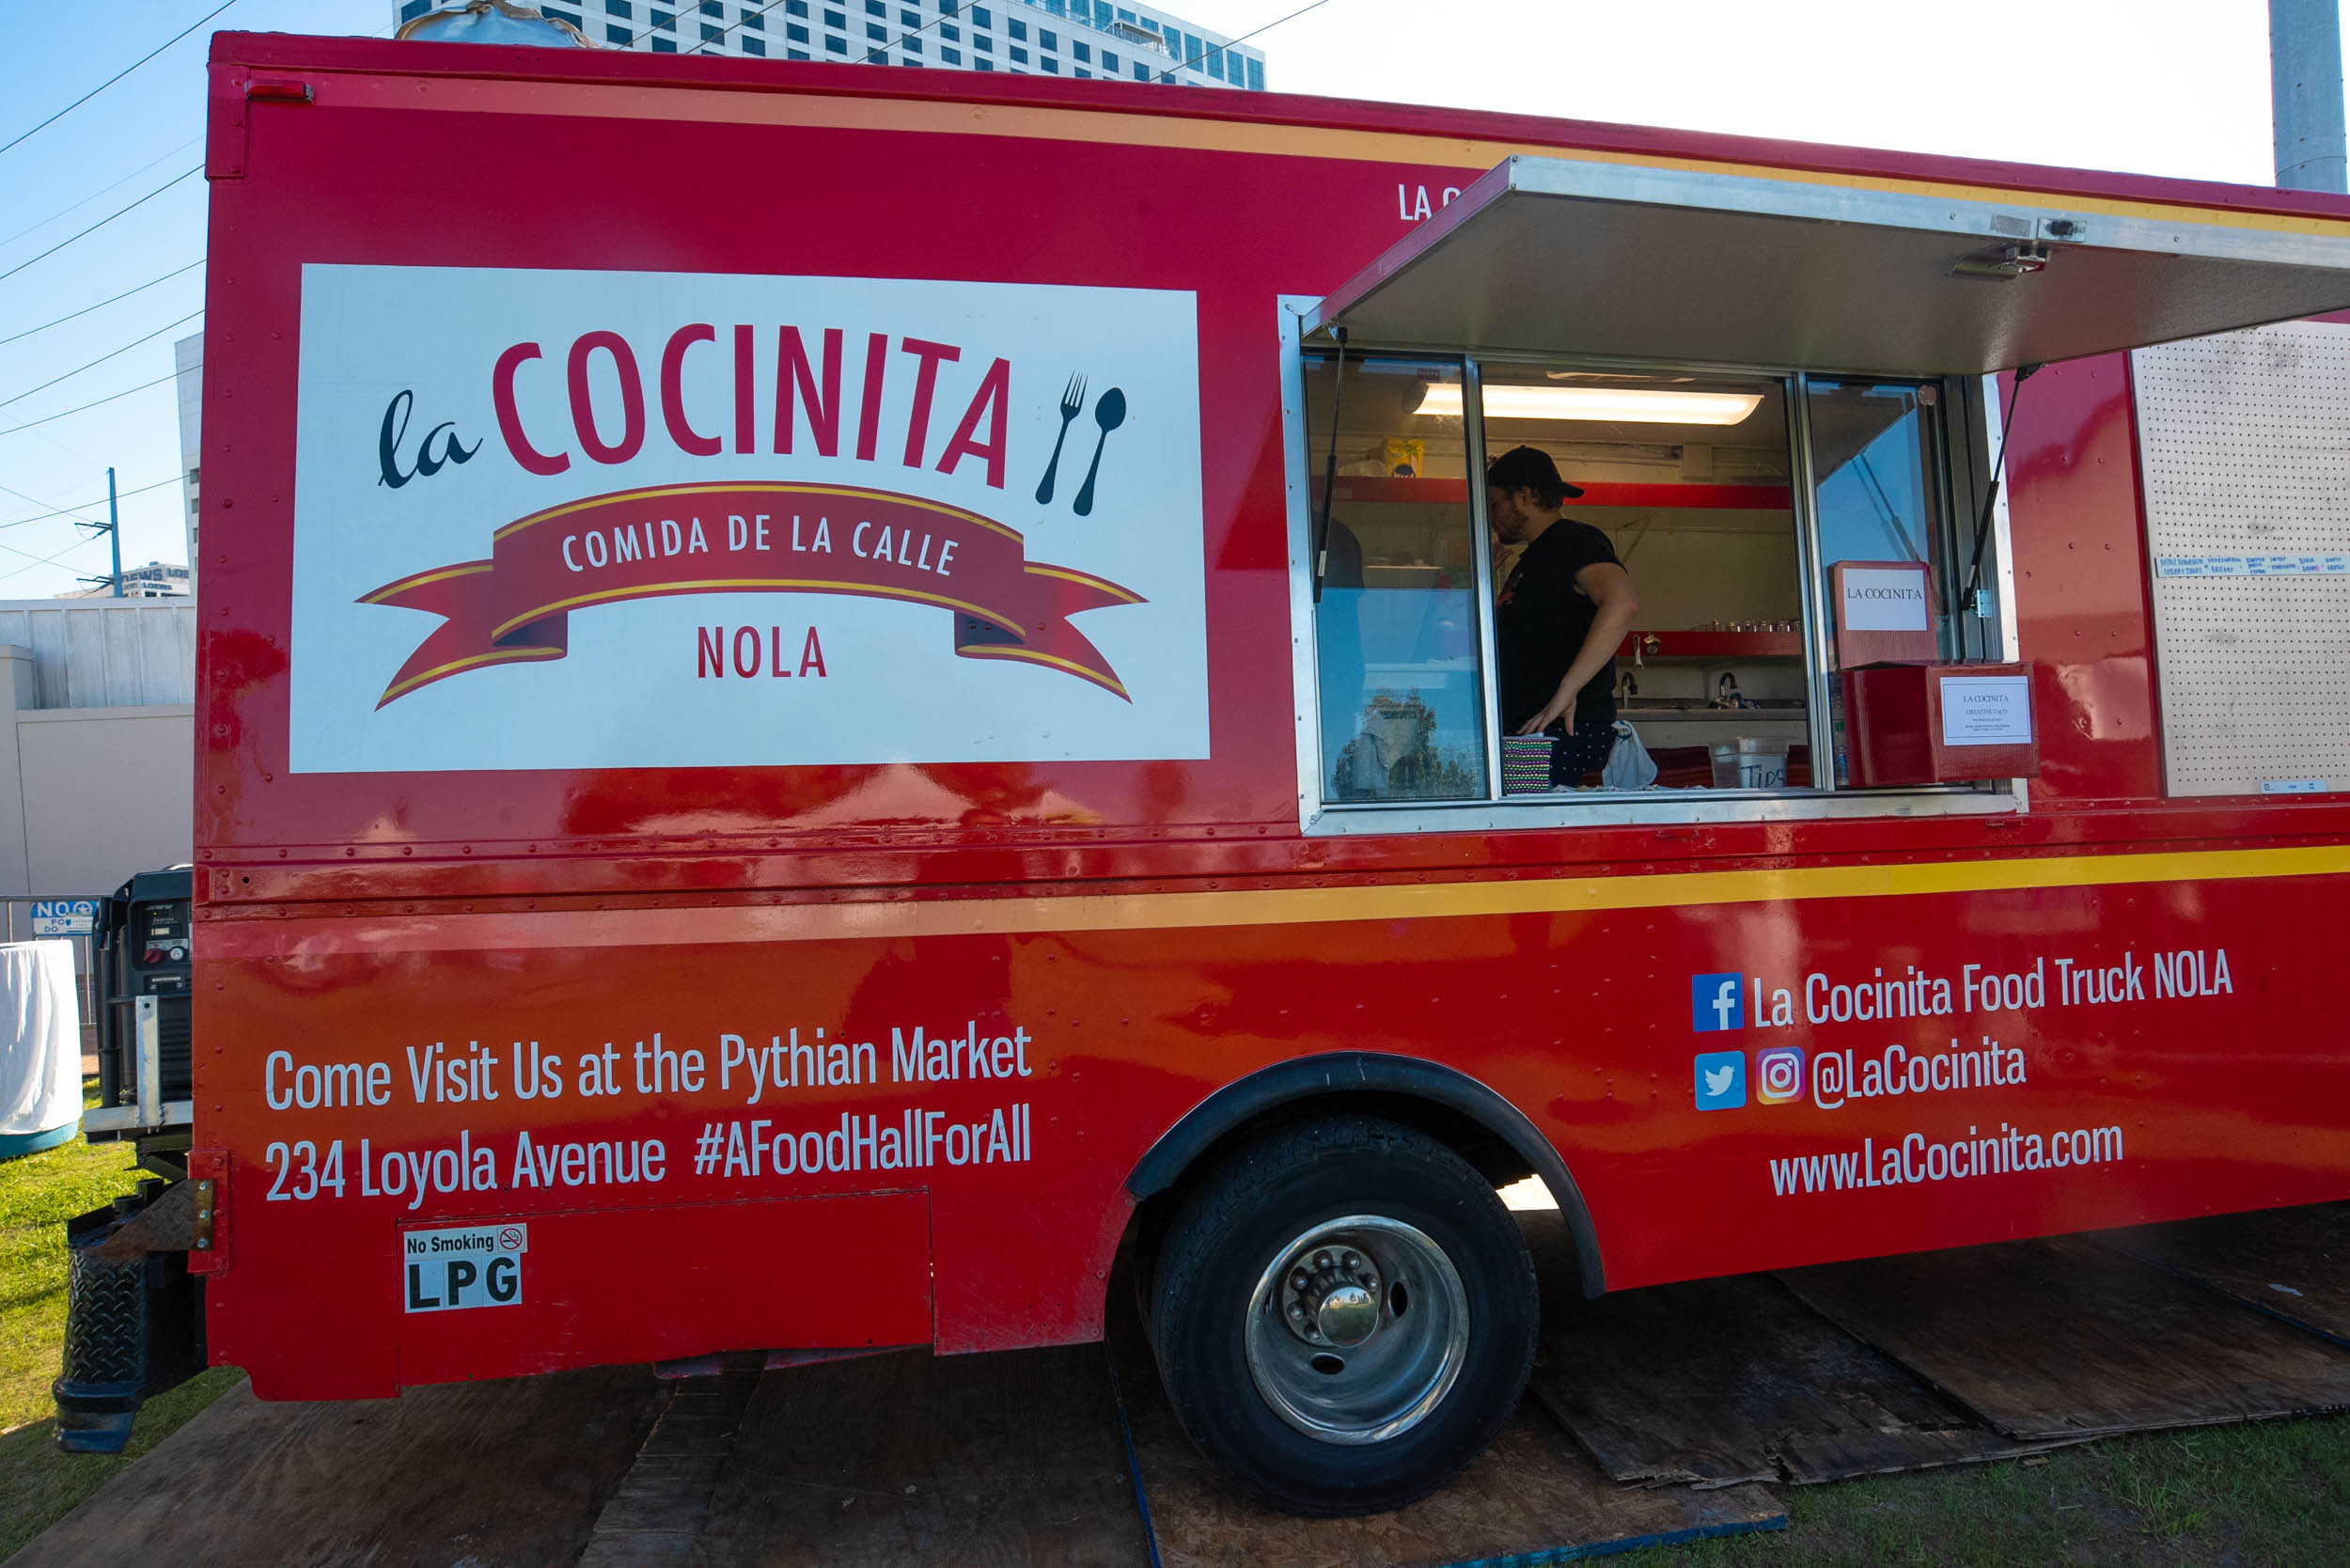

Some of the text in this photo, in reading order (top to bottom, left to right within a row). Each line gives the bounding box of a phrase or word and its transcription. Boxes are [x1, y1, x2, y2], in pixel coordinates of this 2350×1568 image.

[1398, 183, 1432, 221] LA
[377, 322, 1010, 490] la COCINITA
[562, 514, 959, 576] COMIDA DE LA CALLE
[1847, 588, 1922, 600] LA COCINITA
[697, 626, 827, 679] NOLA
[1754, 949, 2233, 1027] La Cocinita Food Truck NOLA
[265, 1020, 1032, 1110] Come Visit Us at the Pythian Market
[1812, 1035, 2026, 1109] @LaCocinita
[266, 1103, 1031, 1210] 234 Loyola Avenue #AFoodHallForAll
[1770, 1122, 2123, 1196] www.LaCocinita.com
[407, 1232, 494, 1254] No Smoking
[408, 1256, 518, 1309] LPG
